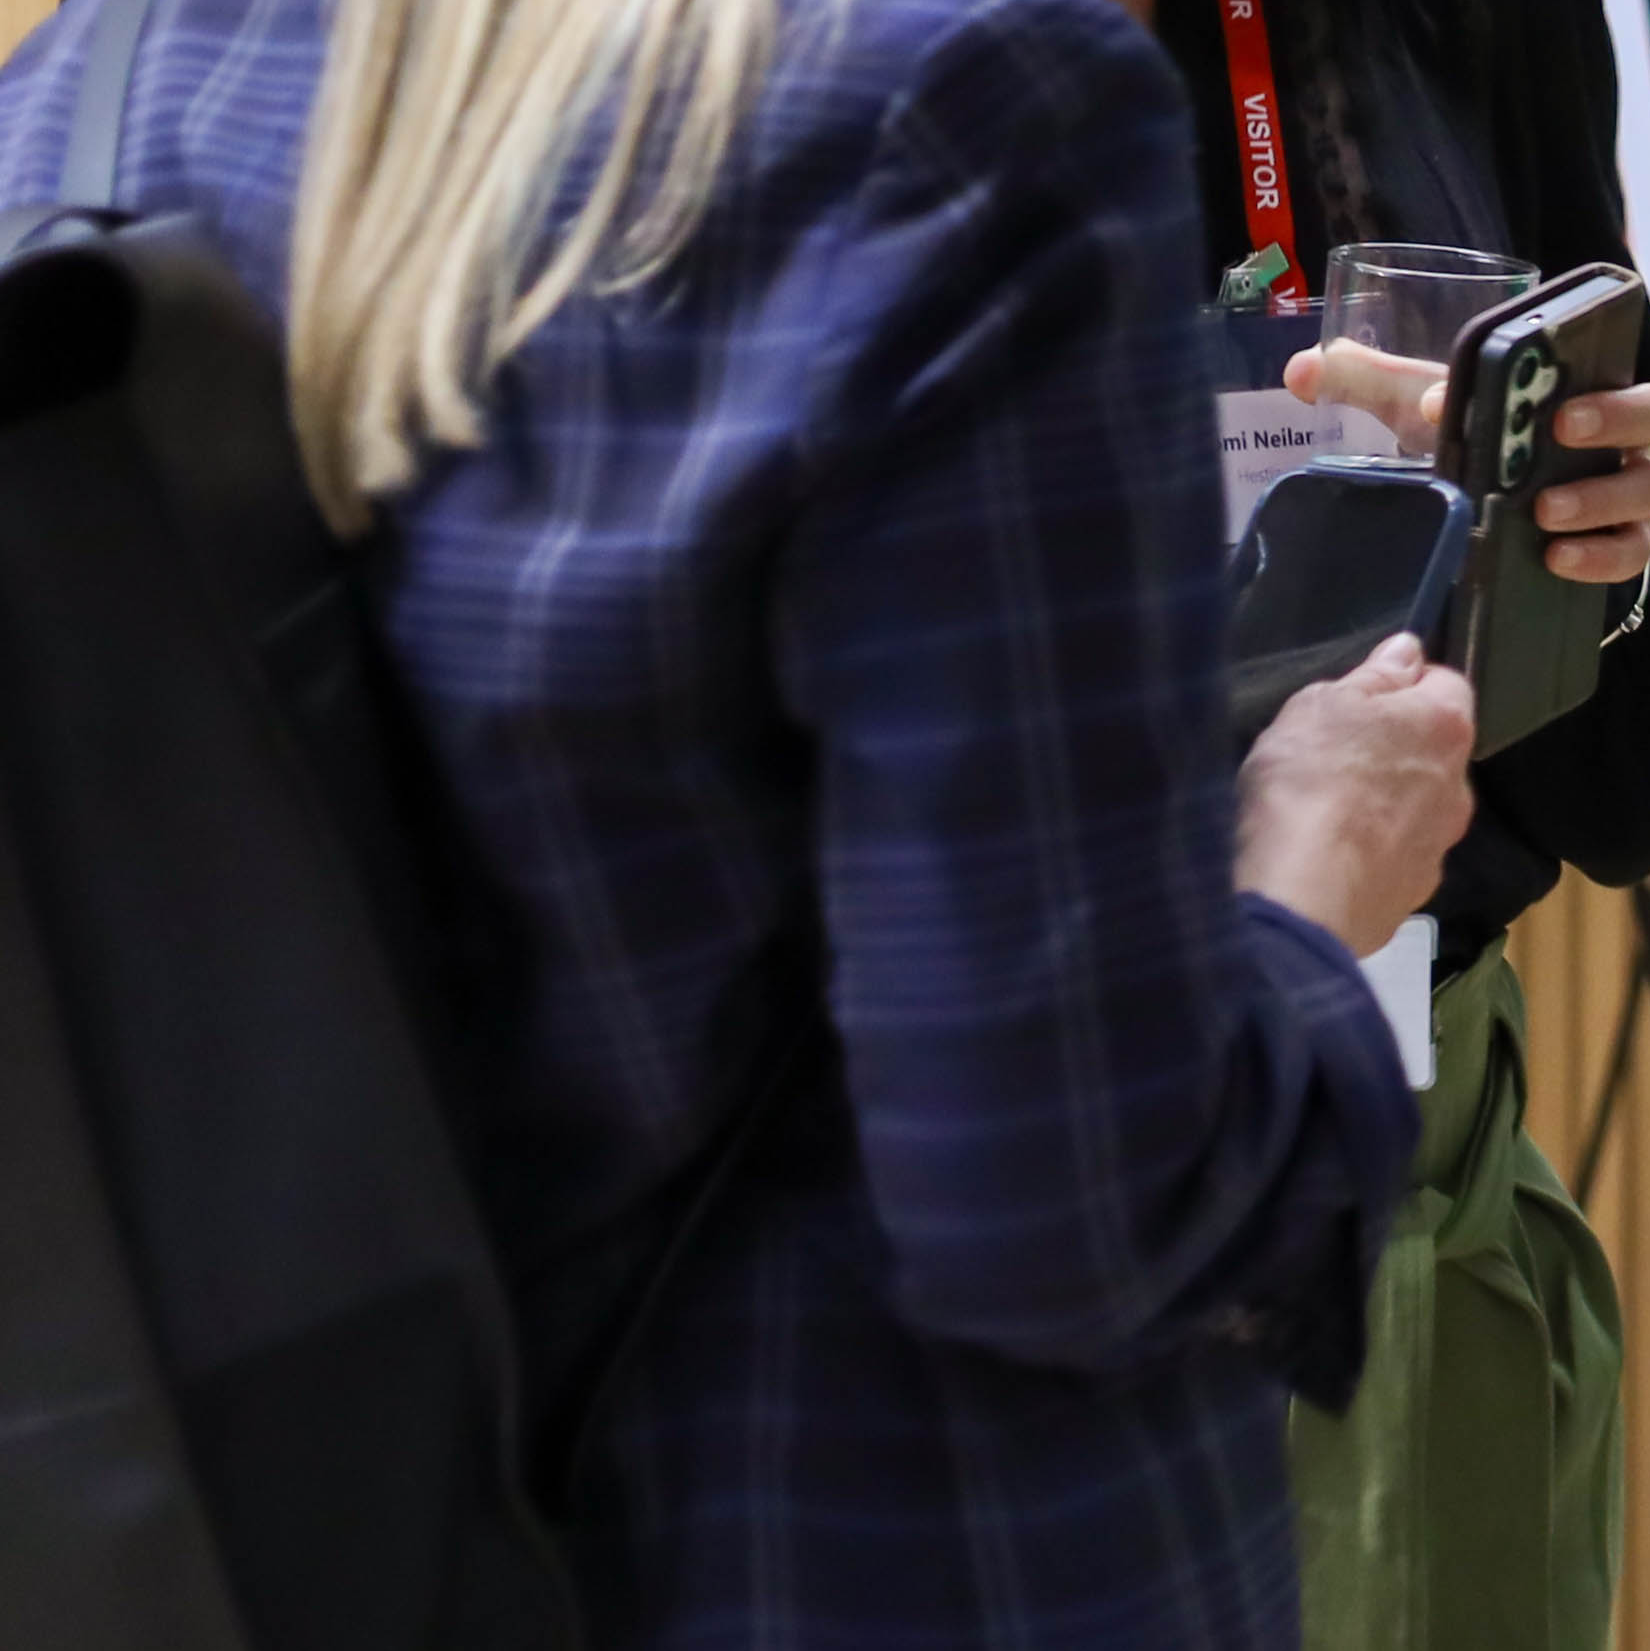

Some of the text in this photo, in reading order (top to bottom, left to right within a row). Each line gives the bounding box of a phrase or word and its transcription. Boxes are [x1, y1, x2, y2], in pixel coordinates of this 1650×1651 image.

[1242, 92, 1280, 210] VISITOR
[1221, 426, 1316, 451] mi Neilar
